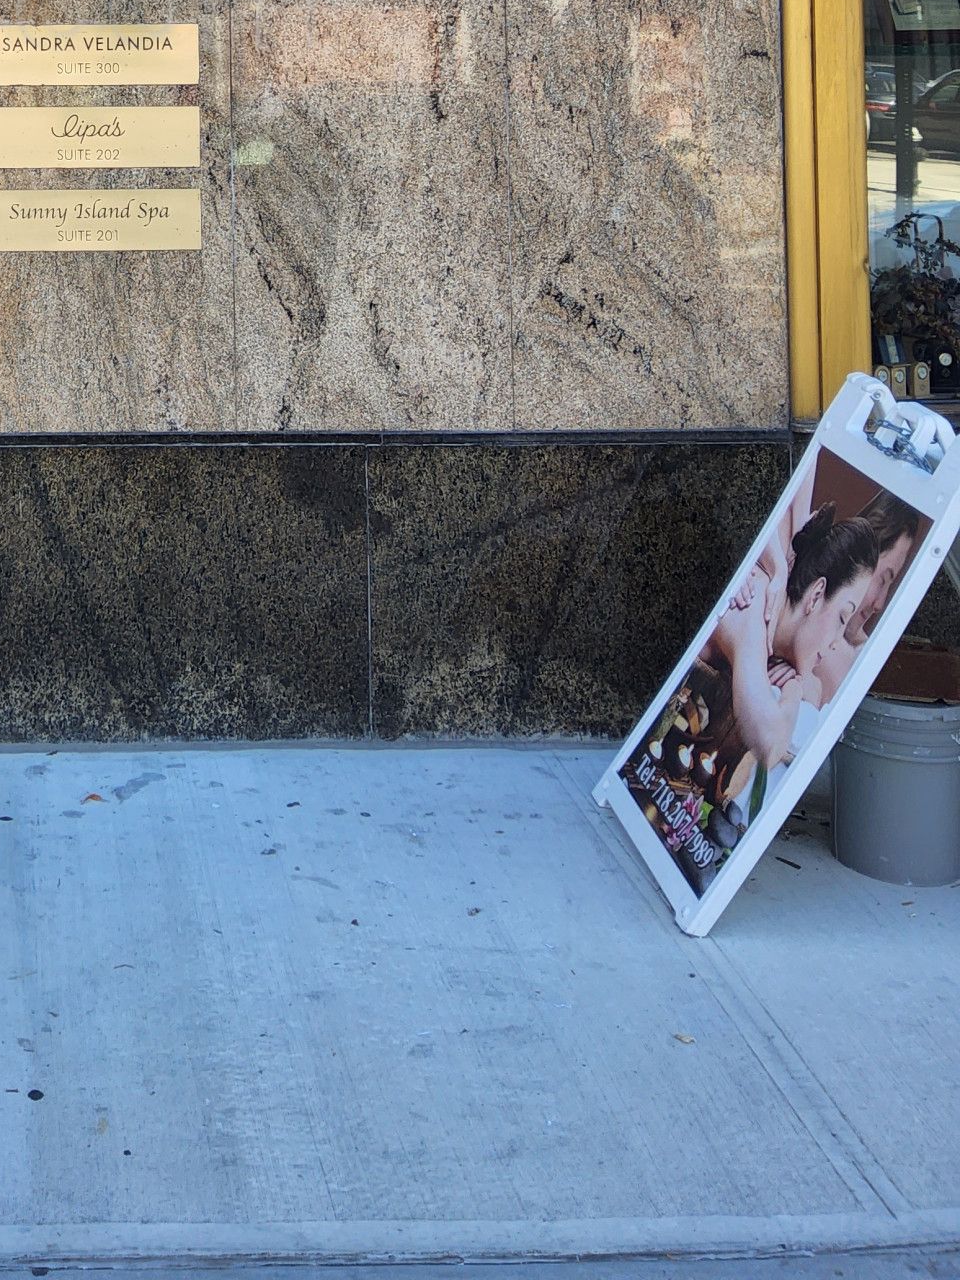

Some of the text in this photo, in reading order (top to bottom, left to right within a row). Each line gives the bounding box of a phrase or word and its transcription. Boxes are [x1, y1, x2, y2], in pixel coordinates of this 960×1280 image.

[2, 36, 173, 52] SANDRA VELANDIA
[57, 62, 120, 74] SUITE 300
[57, 149, 120, 161] SUITE 202
[9, 198, 170, 227] Sunny Island Spa
[57, 230, 119, 242] SUITE 201
[635, 753, 715, 869] Tel: 718.207.7989
